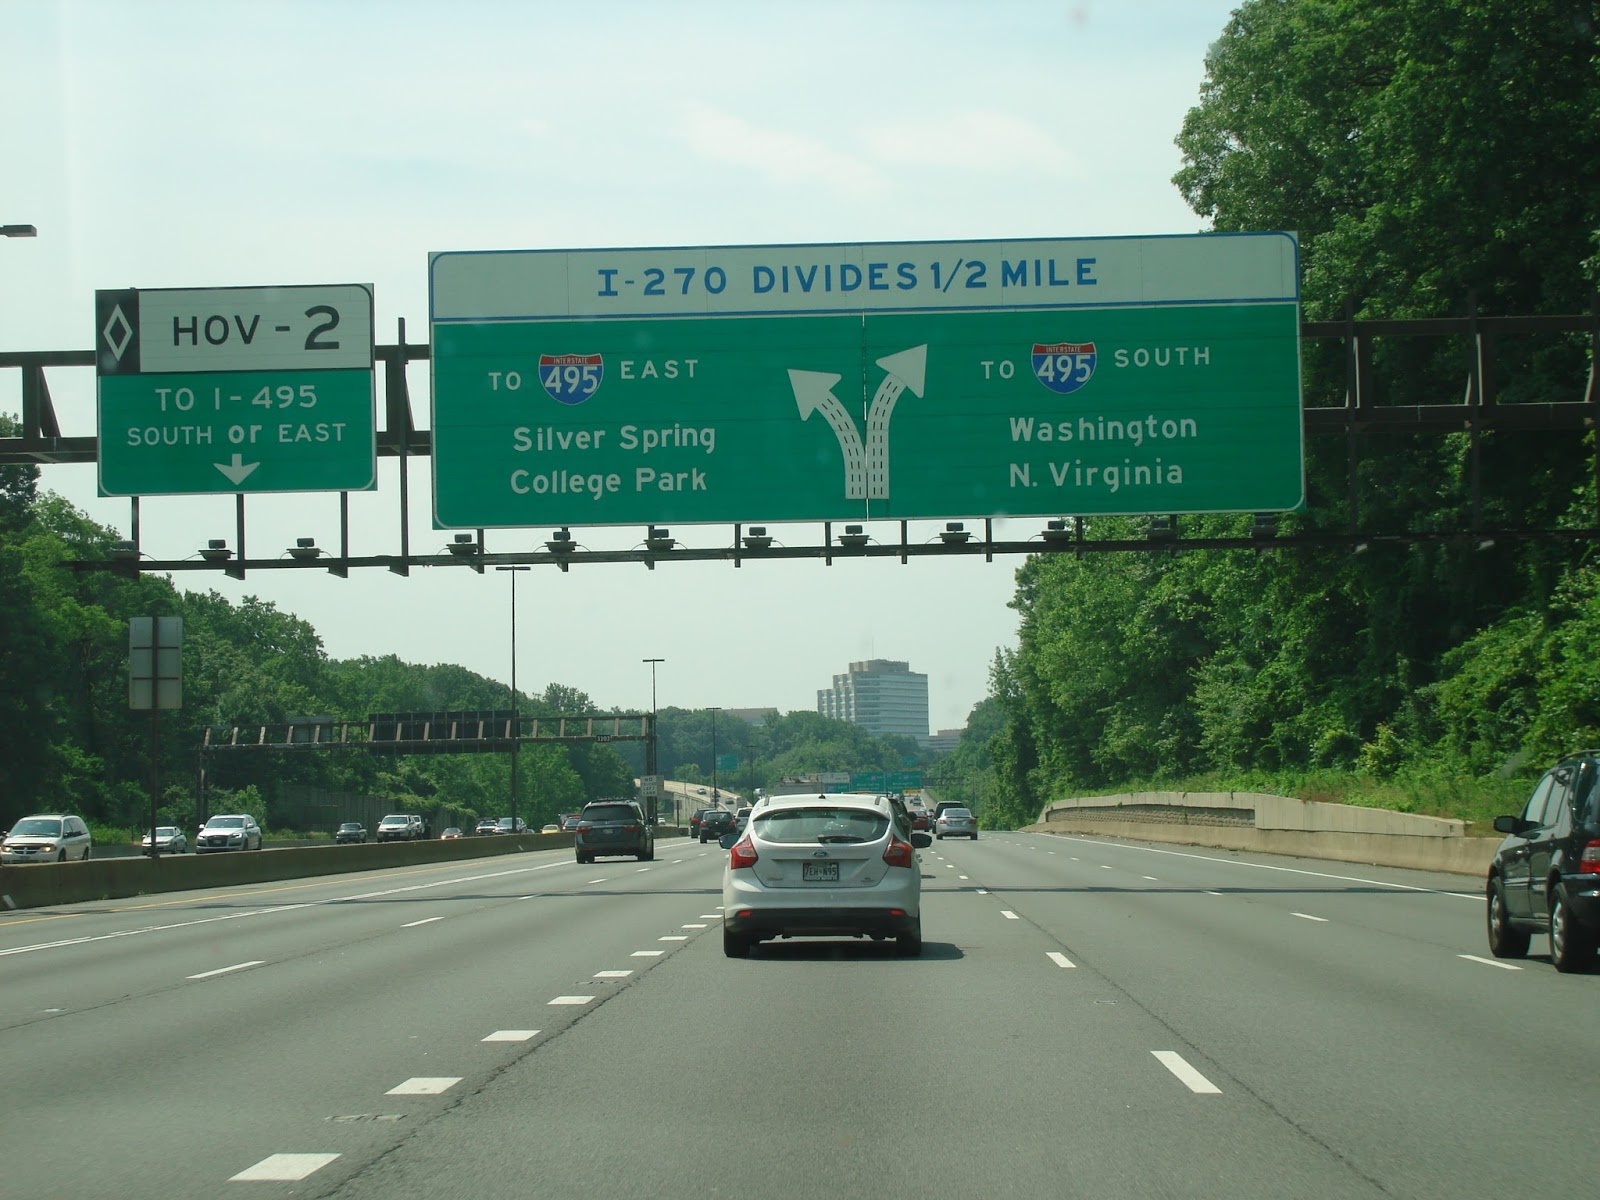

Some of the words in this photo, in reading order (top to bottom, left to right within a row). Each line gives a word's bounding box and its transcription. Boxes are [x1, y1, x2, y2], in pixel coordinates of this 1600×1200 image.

[598, 267, 727, 297] I-270
[753, 262, 918, 294] DIVIDES
[930, 258, 987, 293] 1/2
[1001, 258, 1098, 287] MILE
[488, 371, 522, 391] TO
[544, 366, 598, 394] 495
[620, 359, 698, 380] EAST
[980, 360, 1015, 379] TO
[1037, 355, 1091, 382] 495
[1114, 347, 1210, 368] SOUTH
[155, 387, 194, 411] TO
[127, 426, 212, 446] SOUTH
[228, 425, 262, 444] or
[278, 423, 346, 443] EAST
[513, 426, 606, 452] Silver
[619, 423, 716, 454] Spring
[1009, 415, 1198, 446] Washington
[510, 469, 622, 501] College
[635, 467, 707, 492] Park
[1009, 463, 1038, 488] N.
[1048, 458, 1183, 493] Virginia
